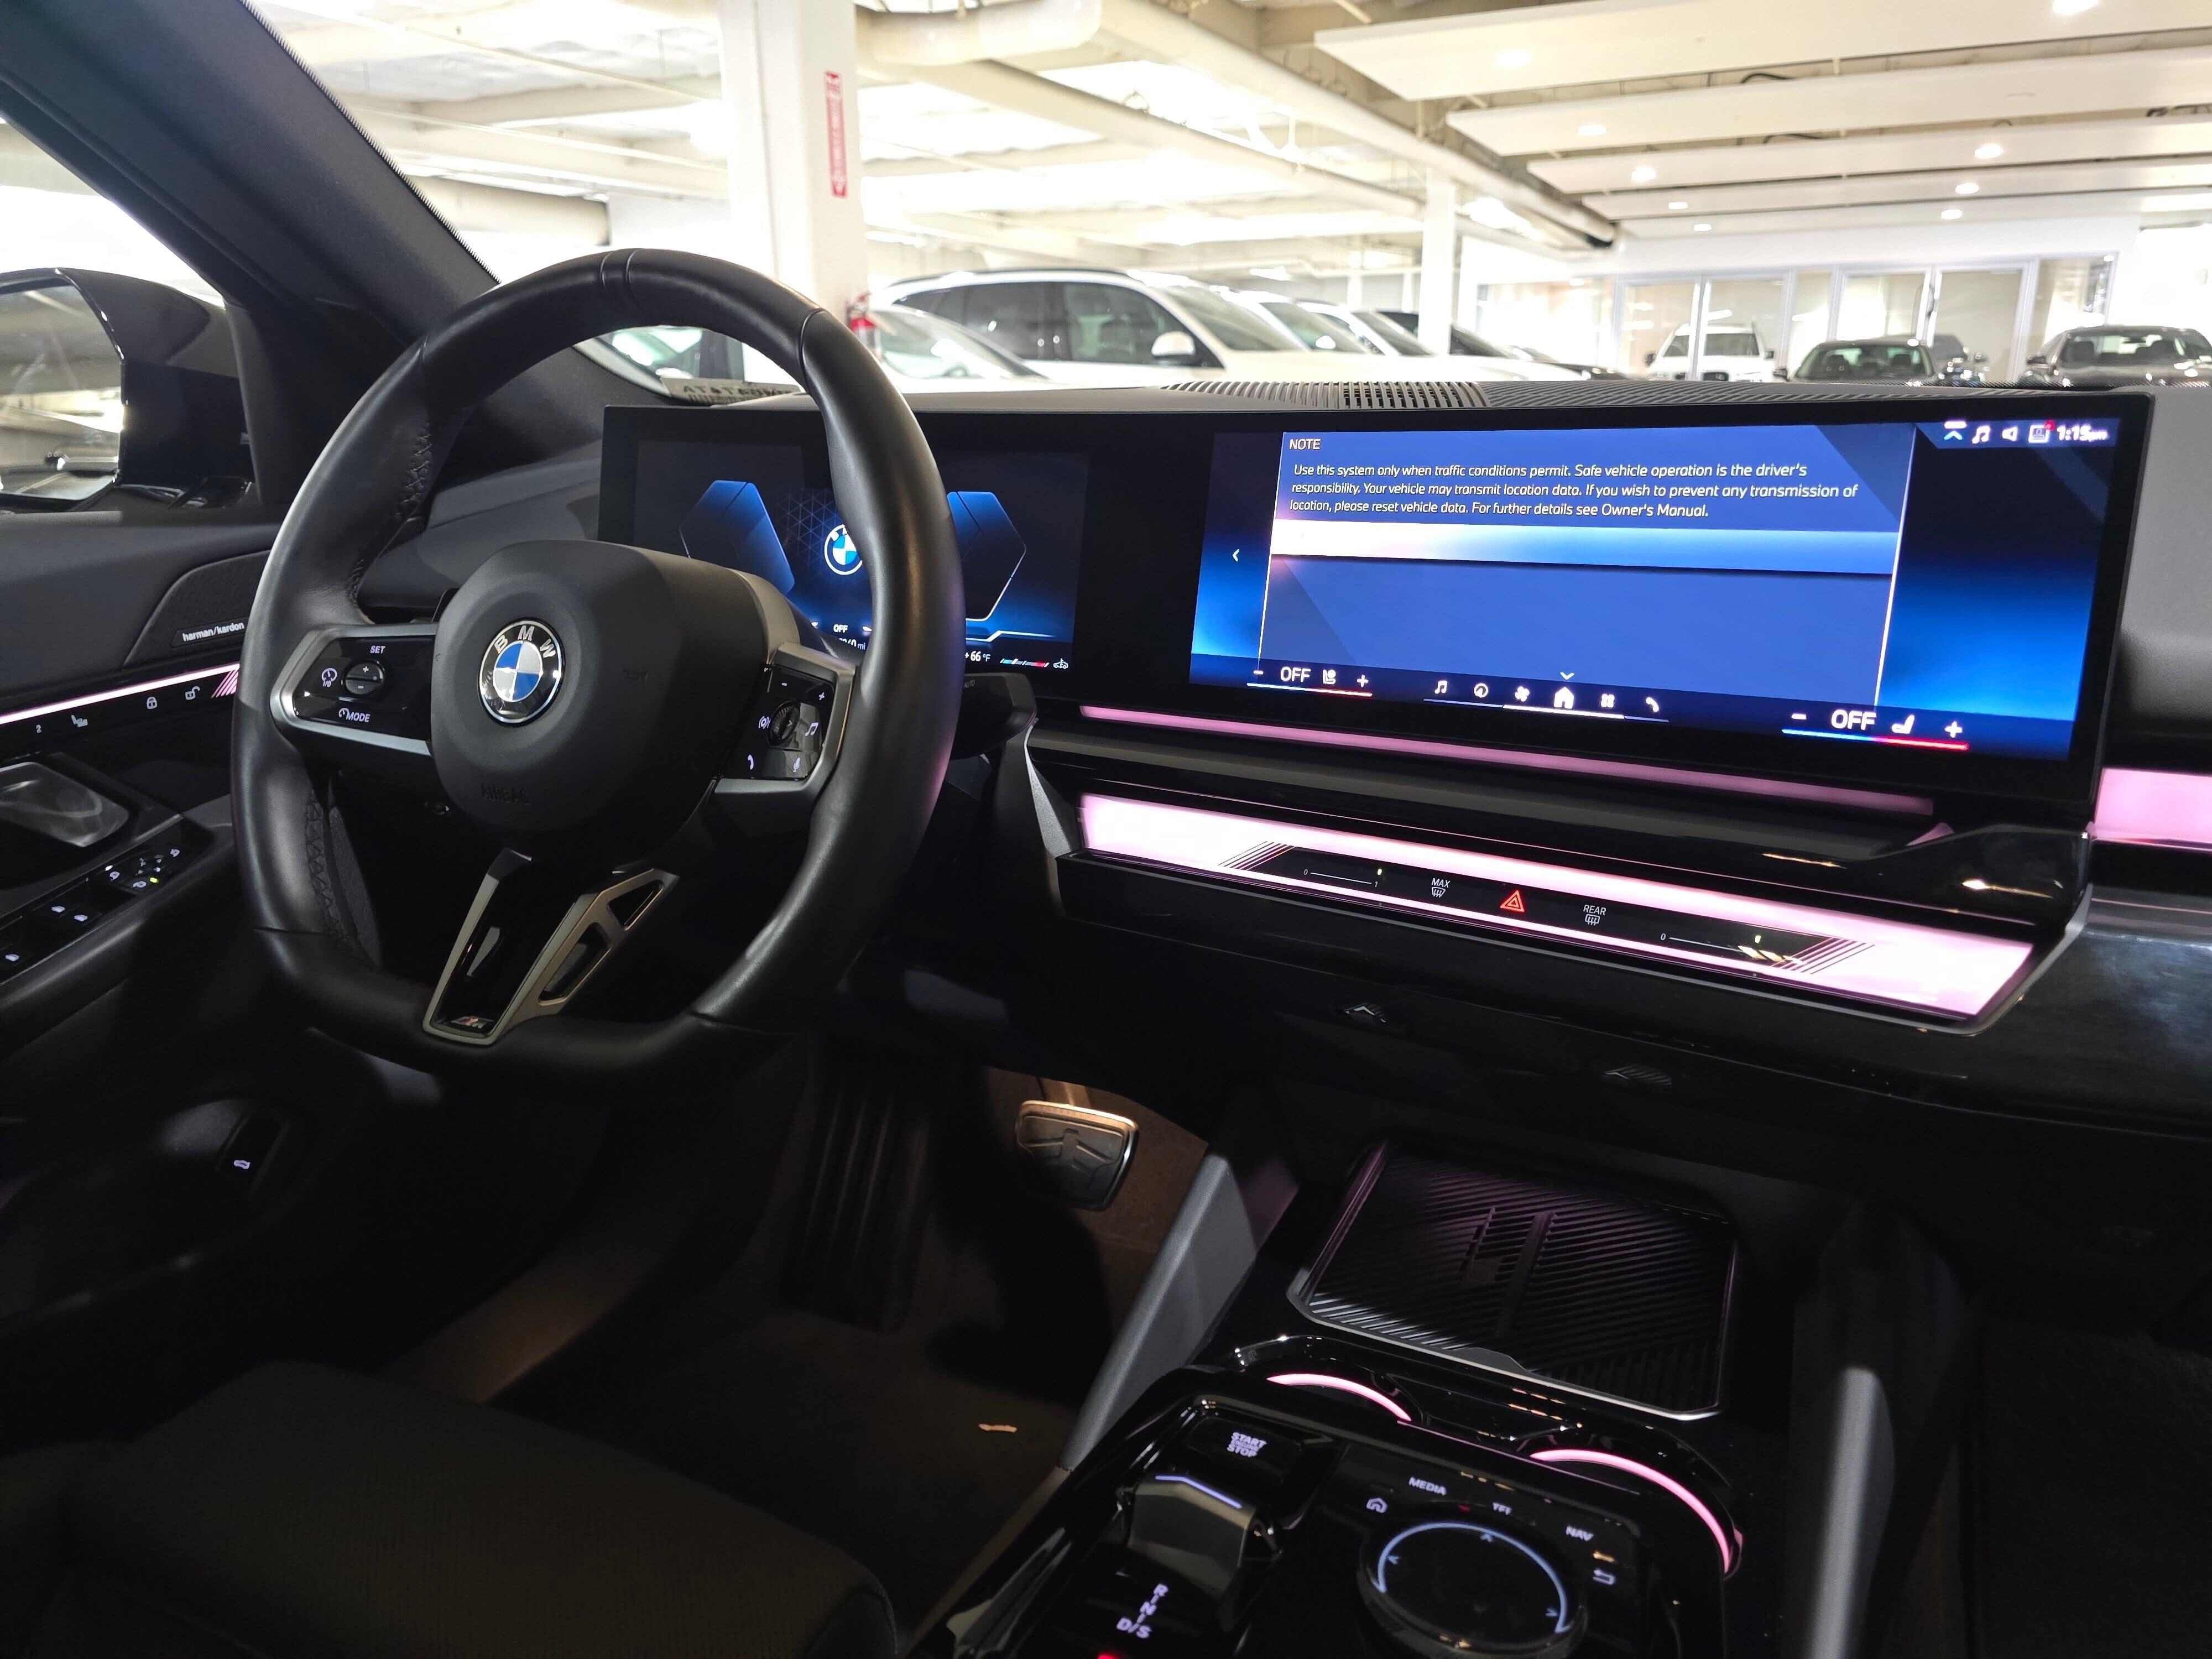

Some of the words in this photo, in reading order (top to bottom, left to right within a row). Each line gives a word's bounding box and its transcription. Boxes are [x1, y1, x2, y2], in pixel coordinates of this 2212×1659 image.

[1289, 439, 1321, 450] NOTE
[1294, 464, 1314, 476] Use
[1317, 464, 1335, 476] this
[1337, 465, 1375, 478] system
[1378, 465, 1401, 478] only
[1403, 465, 1432, 476] when
[1434, 465, 1465, 476] traffic
[1468, 465, 1527, 476] conditions
[1530, 465, 1571, 478] permit.
[1574, 464, 1602, 477] Safe
[1605, 464, 1647, 477] vehicle
[1651, 463, 1713, 478] operation
[1717, 463, 1727, 476] is
[1730, 464, 1752, 476] the
[1756, 463, 1807, 477] driver's
[1292, 482, 1360, 495] responsibility.
[1363, 483, 1387, 494] Your
[1389, 483, 1425, 494] vehicle
[1428, 486, 1452, 497] may
[1454, 483, 1501, 495] transmit
[1504, 483, 1548, 495] location
[1552, 484, 1582, 496] data.
[1585, 484, 1597, 496] If
[1596, 487, 1618, 498] you
[1621, 483, 1650, 496] wish
[1653, 485, 1666, 497] to
[1669, 486, 1720, 498] prevent
[1722, 487, 1747, 499] any
[1750, 484, 1838, 498] transmission
[1843, 484, 1859, 498] of
[1290, 499, 1332, 512] location,
[1334, 500, 1369, 513] please
[1371, 501, 1399, 512] reset
[1400, 501, 1438, 513] vehicle
[1441, 502, 1469, 513] data.
[1472, 502, 1491, 514] For
[1493, 502, 1532, 515] further
[1533, 503, 1573, 515] details
[1576, 505, 1598, 515] see
[1601, 503, 1653, 517] Owner's
[1657, 503, 1708, 517] Manual.
[833, 624, 848, 633] OFF
[494, 625, 556, 658] BMW
[370, 645, 386, 654] SET
[1280, 666, 1311, 682] OFF
[346, 712, 371, 722] MODE
[1831, 709, 1876, 731] OFF
[1431, 878, 1451, 888] MAX
[1583, 904, 1606, 915] REAR
[1231, 1432, 1267, 1448] START
[1409, 1477, 1447, 1496] MEDIA
[1566, 1525, 1594, 1541] NAV
[1154, 1583, 1168, 1597] R
[1140, 1601, 1156, 1615] N
[1117, 1617, 1151, 1638] D/S
